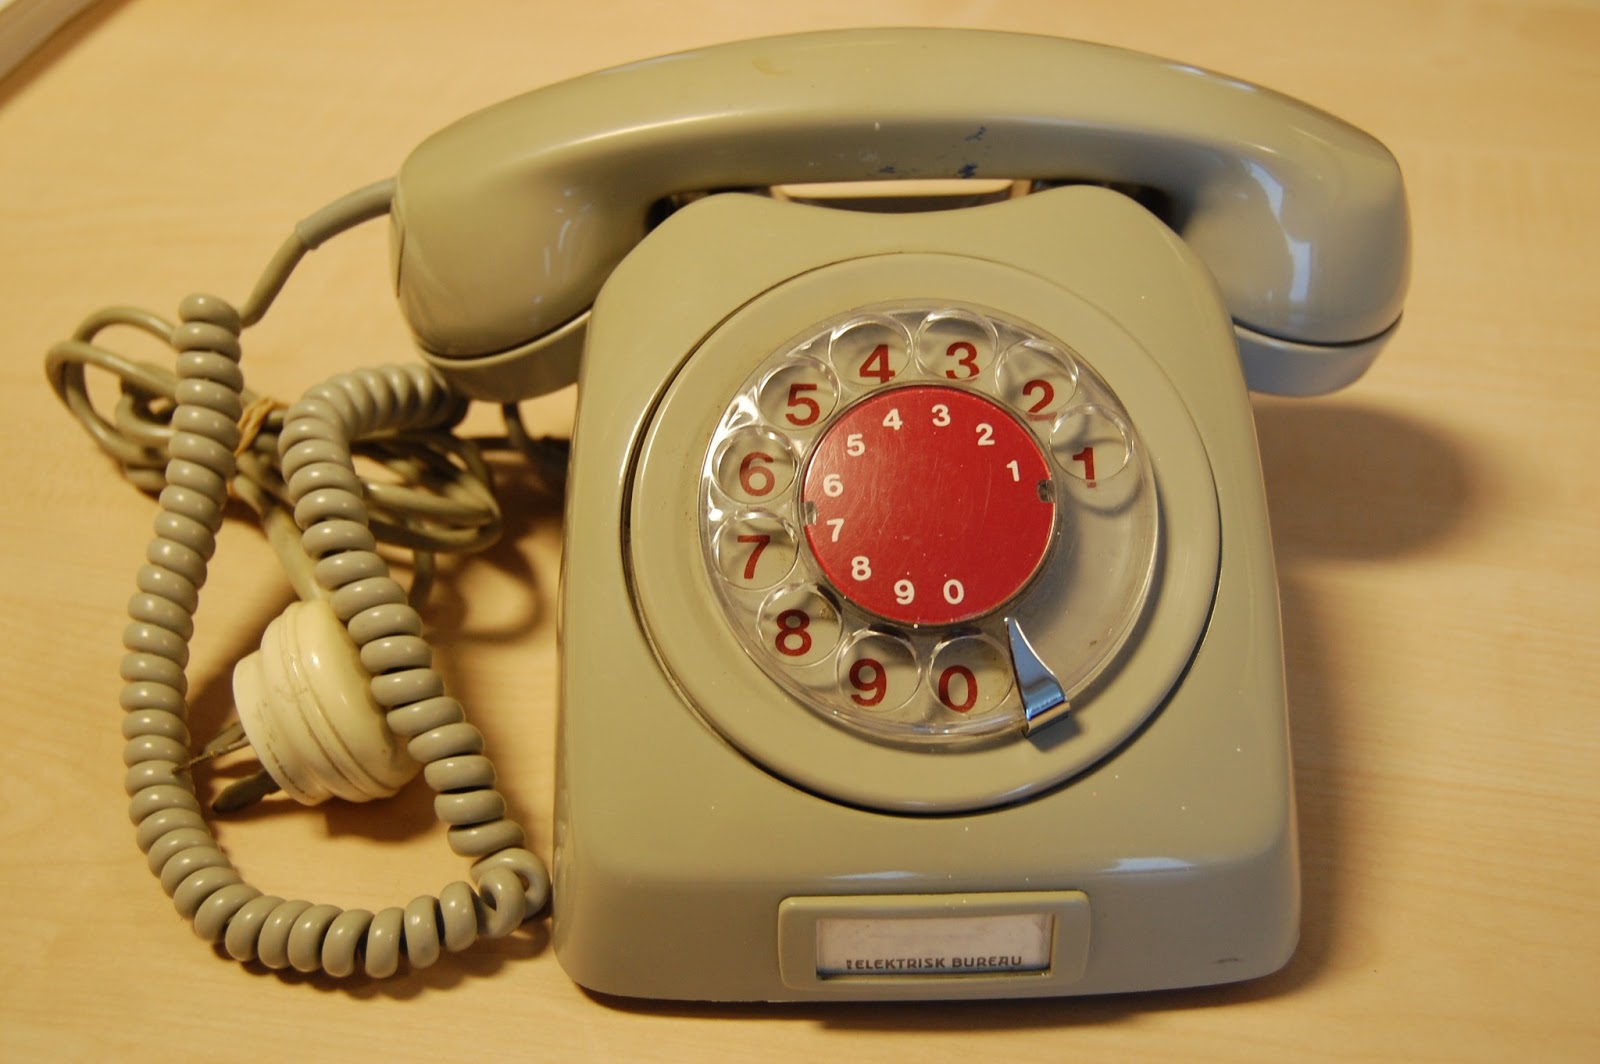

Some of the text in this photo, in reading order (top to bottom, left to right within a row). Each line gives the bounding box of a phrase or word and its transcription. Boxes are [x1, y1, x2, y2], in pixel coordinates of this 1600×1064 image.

[858, 343, 896, 384] 4
[945, 341, 981, 381] 3
[784, 383, 821, 427] 5
[1021, 379, 1056, 420] 2
[882, 408, 903, 431] 4
[931, 403, 952, 427] 3
[846, 433, 866, 457] 5
[975, 422, 996, 446] 2
[738, 451, 776, 497] 6
[1006, 460, 1020, 482] 1
[1072, 446, 1096, 488] 1
[822, 473, 845, 498] 6
[826, 517, 845, 543] 7
[736, 534, 771, 580] 7
[851, 555, 873, 581] 8
[893, 579, 916, 605] 9
[942, 578, 965, 605] 0
[773, 608, 813, 657] 8
[848, 657, 888, 707] 9
[937, 664, 978, 714] 0
[854, 957, 946, 970] ELEKTRISK
[951, 955, 1022, 968] BUREAU
